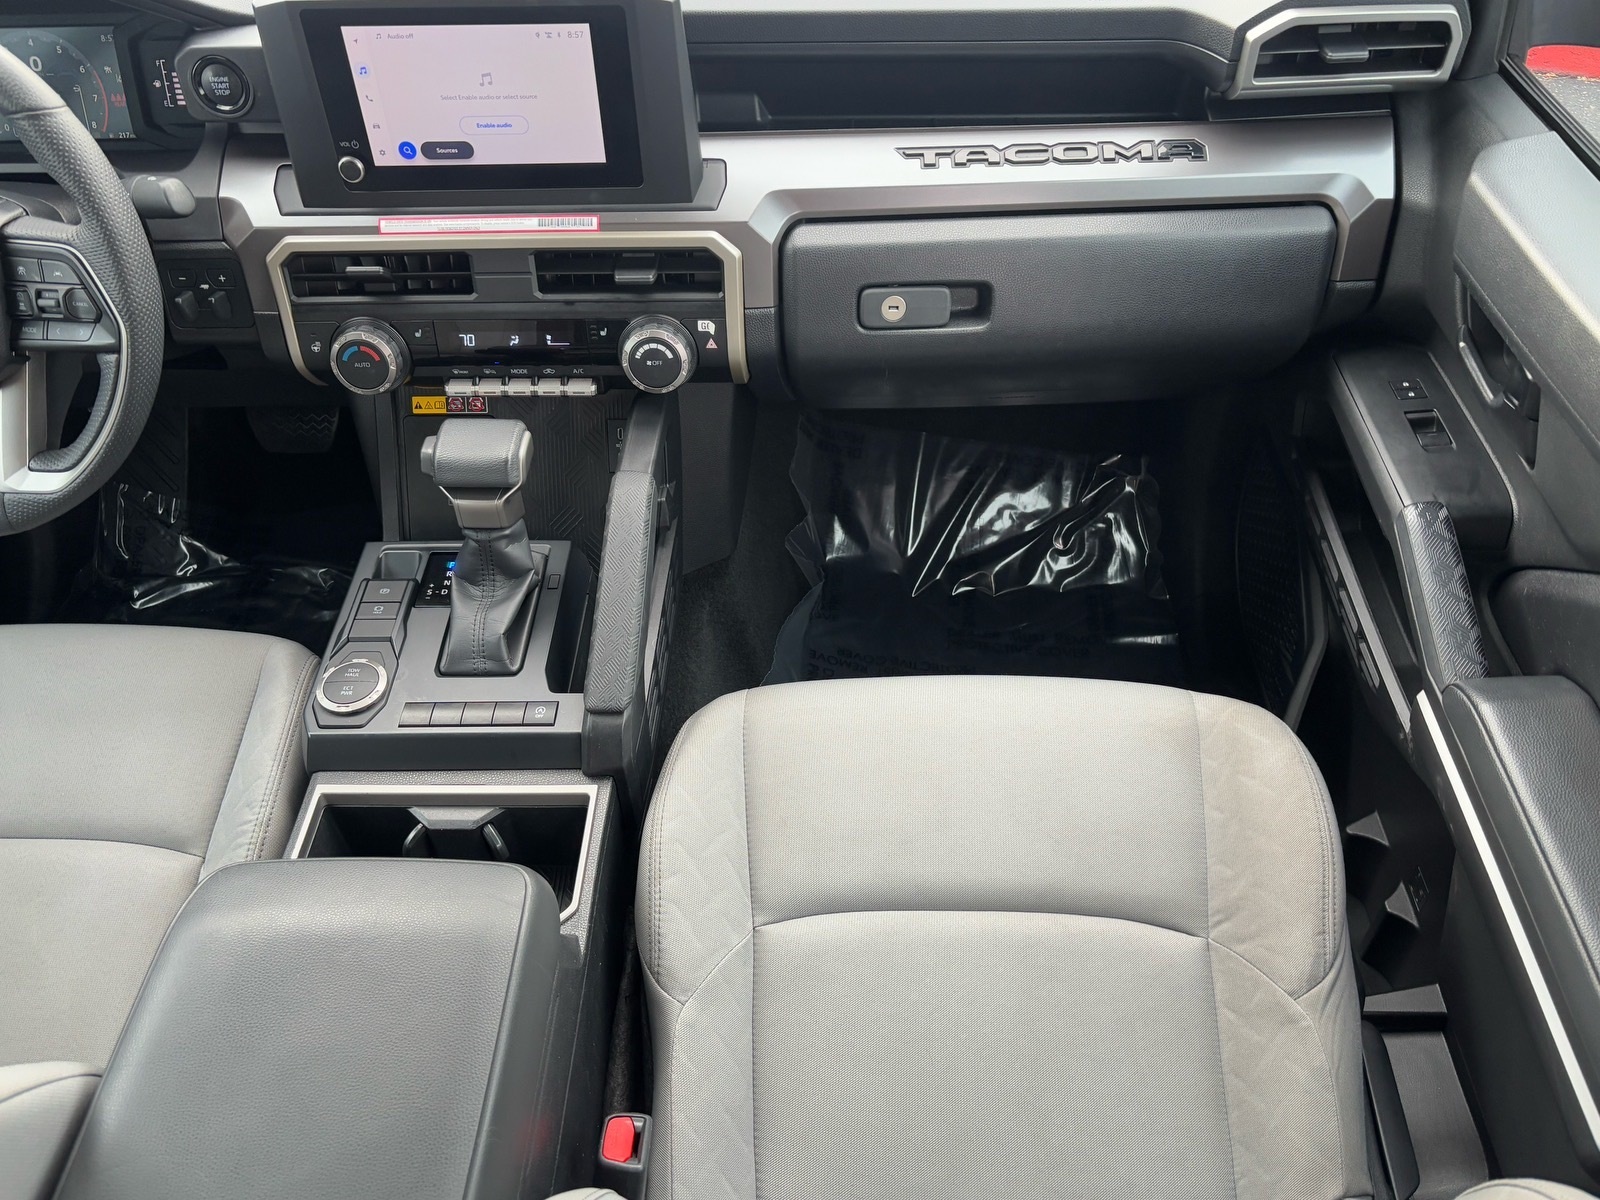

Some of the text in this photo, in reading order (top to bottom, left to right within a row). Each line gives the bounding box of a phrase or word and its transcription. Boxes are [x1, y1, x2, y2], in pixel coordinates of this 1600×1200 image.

[100, 34, 113, 42] 8:5
[567, 30, 584, 39] 8:57
[28, 38, 34, 47] 4
[56, 45, 62, 54] 5
[29, 55, 42, 72] 0
[79, 65, 86, 74] 6
[211, 82, 230, 90] START
[92, 94, 99, 103] 7
[4, 123, 10, 132] 0
[91, 120, 98, 129] 8
[118, 131, 130, 139] 217
[894, 138, 1209, 170] TACOMA
[458, 333, 476, 347] 70
